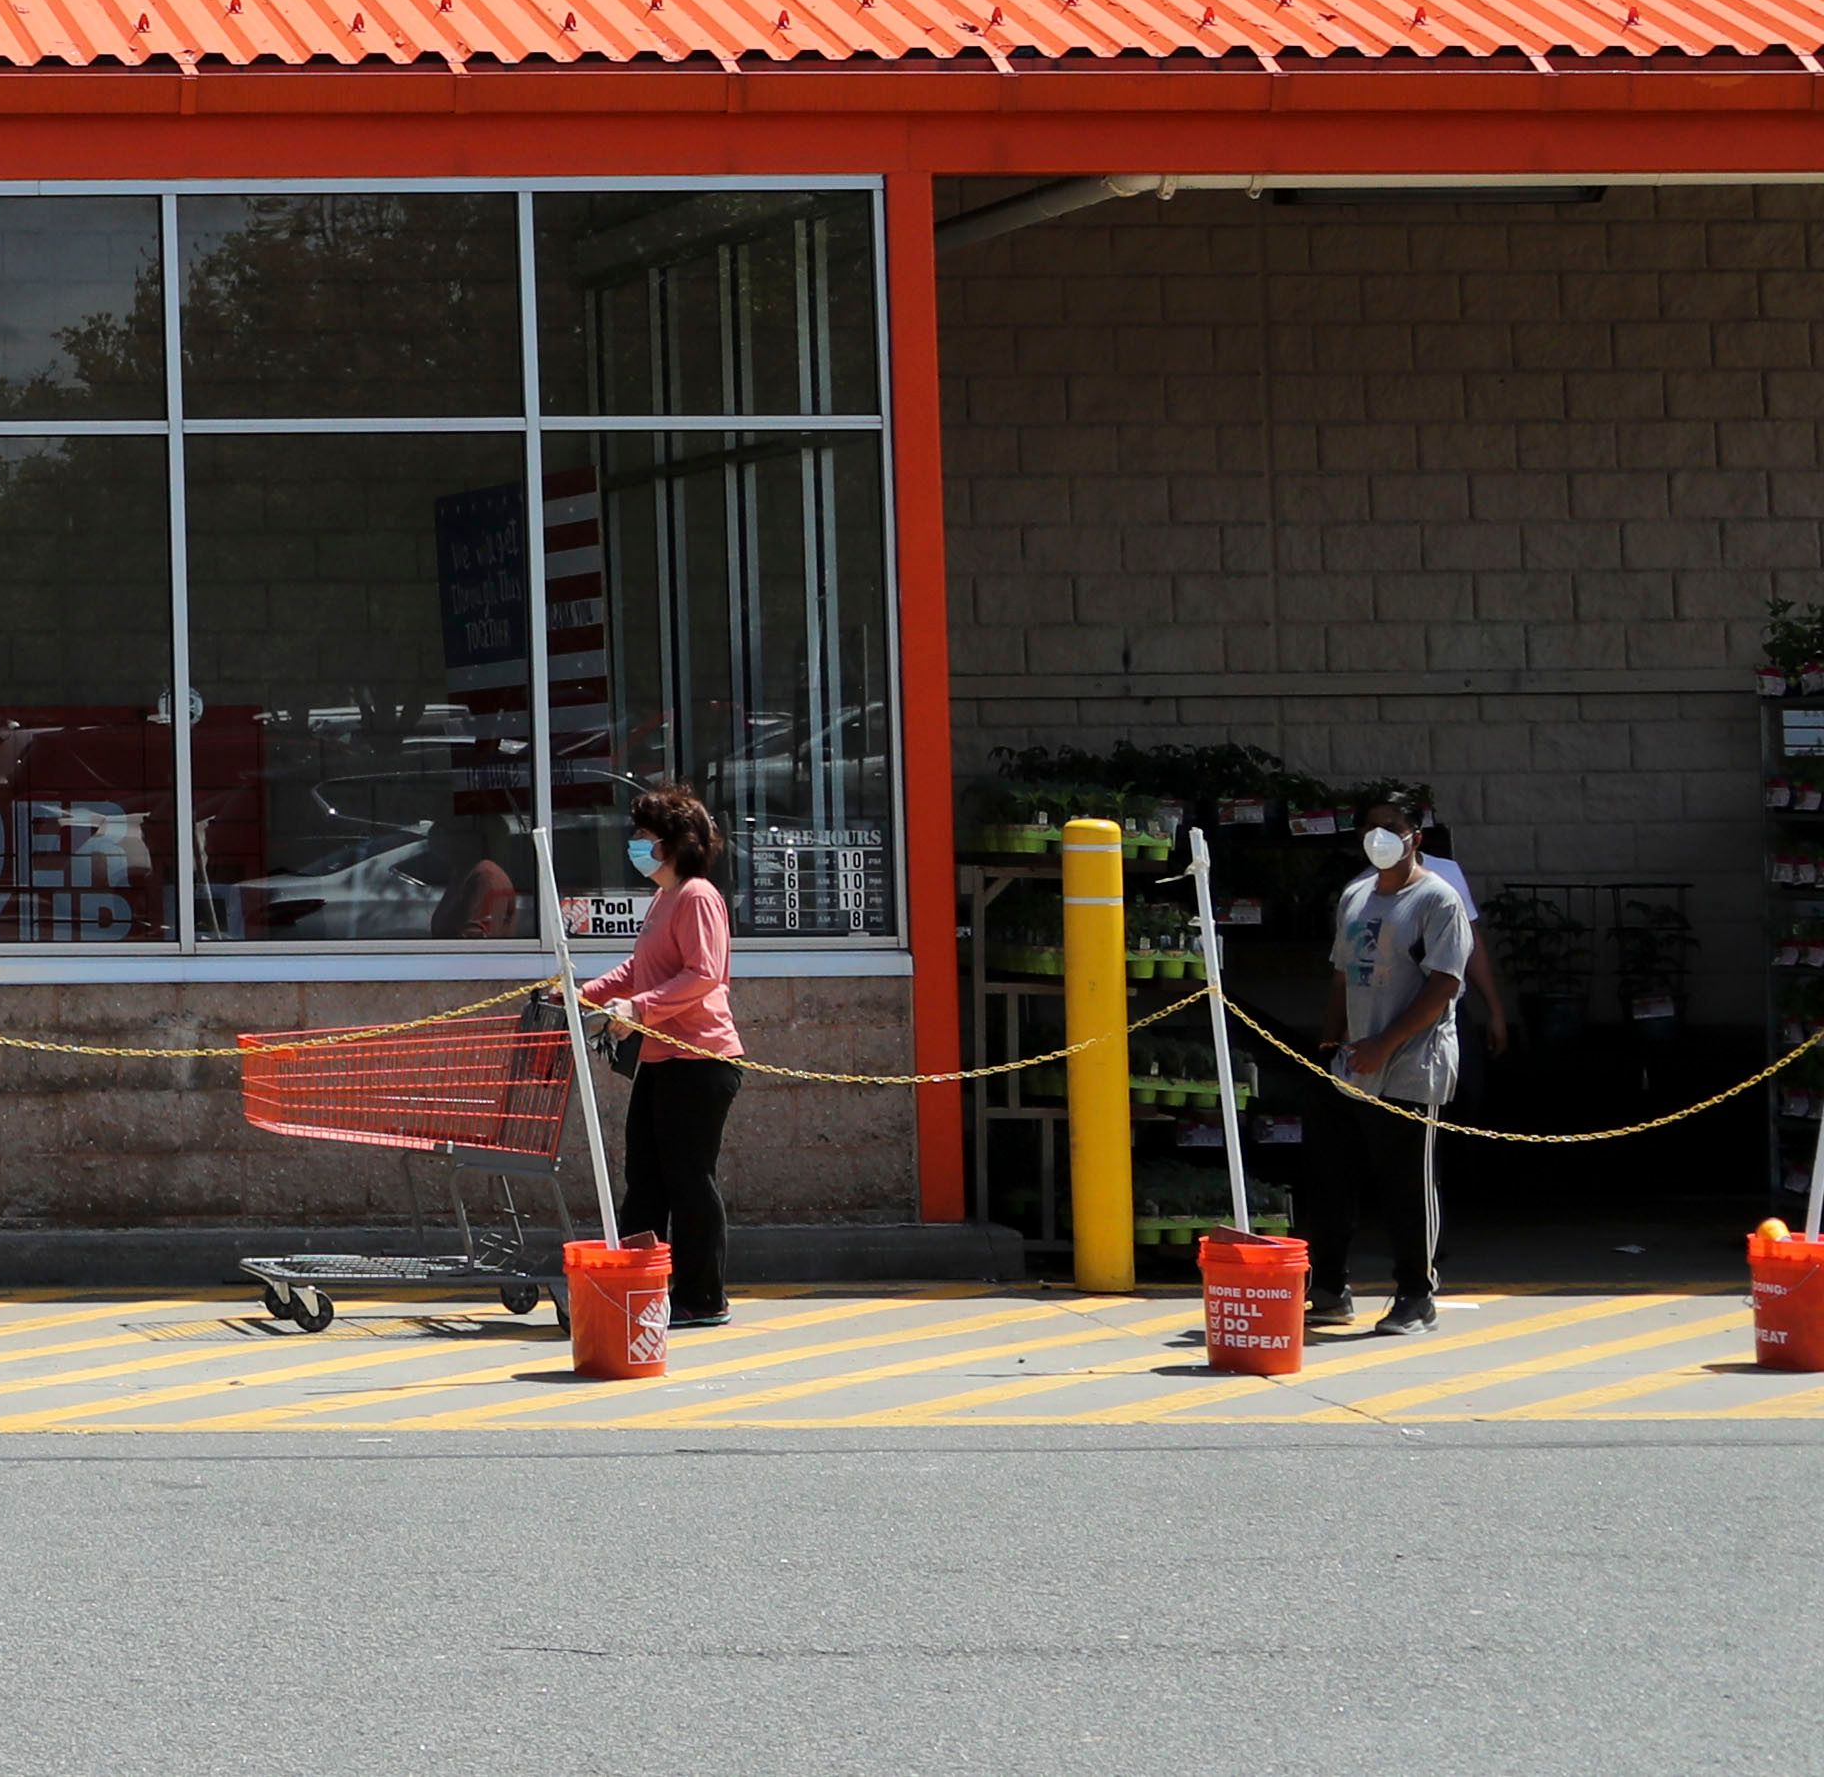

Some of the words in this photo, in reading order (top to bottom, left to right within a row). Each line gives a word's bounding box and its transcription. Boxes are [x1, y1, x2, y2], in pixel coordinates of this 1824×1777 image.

[752, 830, 813, 845] STORE
[817, 830, 881, 845] HOURS
[786, 853, 795, 869] 6
[842, 852, 861, 868] 10
[787, 873, 796, 888] 6
[843, 873, 862, 889] 10
[591, 899, 633, 914] Tool
[788, 893, 796, 908] 6
[843, 892, 862, 908] 10
[788, 912, 797, 927] 8
[853, 911, 861, 927] 8
[1208, 1285, 1241, 1297] MORE
[1246, 1288, 1292, 1299] DOING:
[1223, 1302, 1263, 1317] FILL
[1224, 1318, 1249, 1331] DO
[1224, 1334, 1291, 1349] REPEAT
